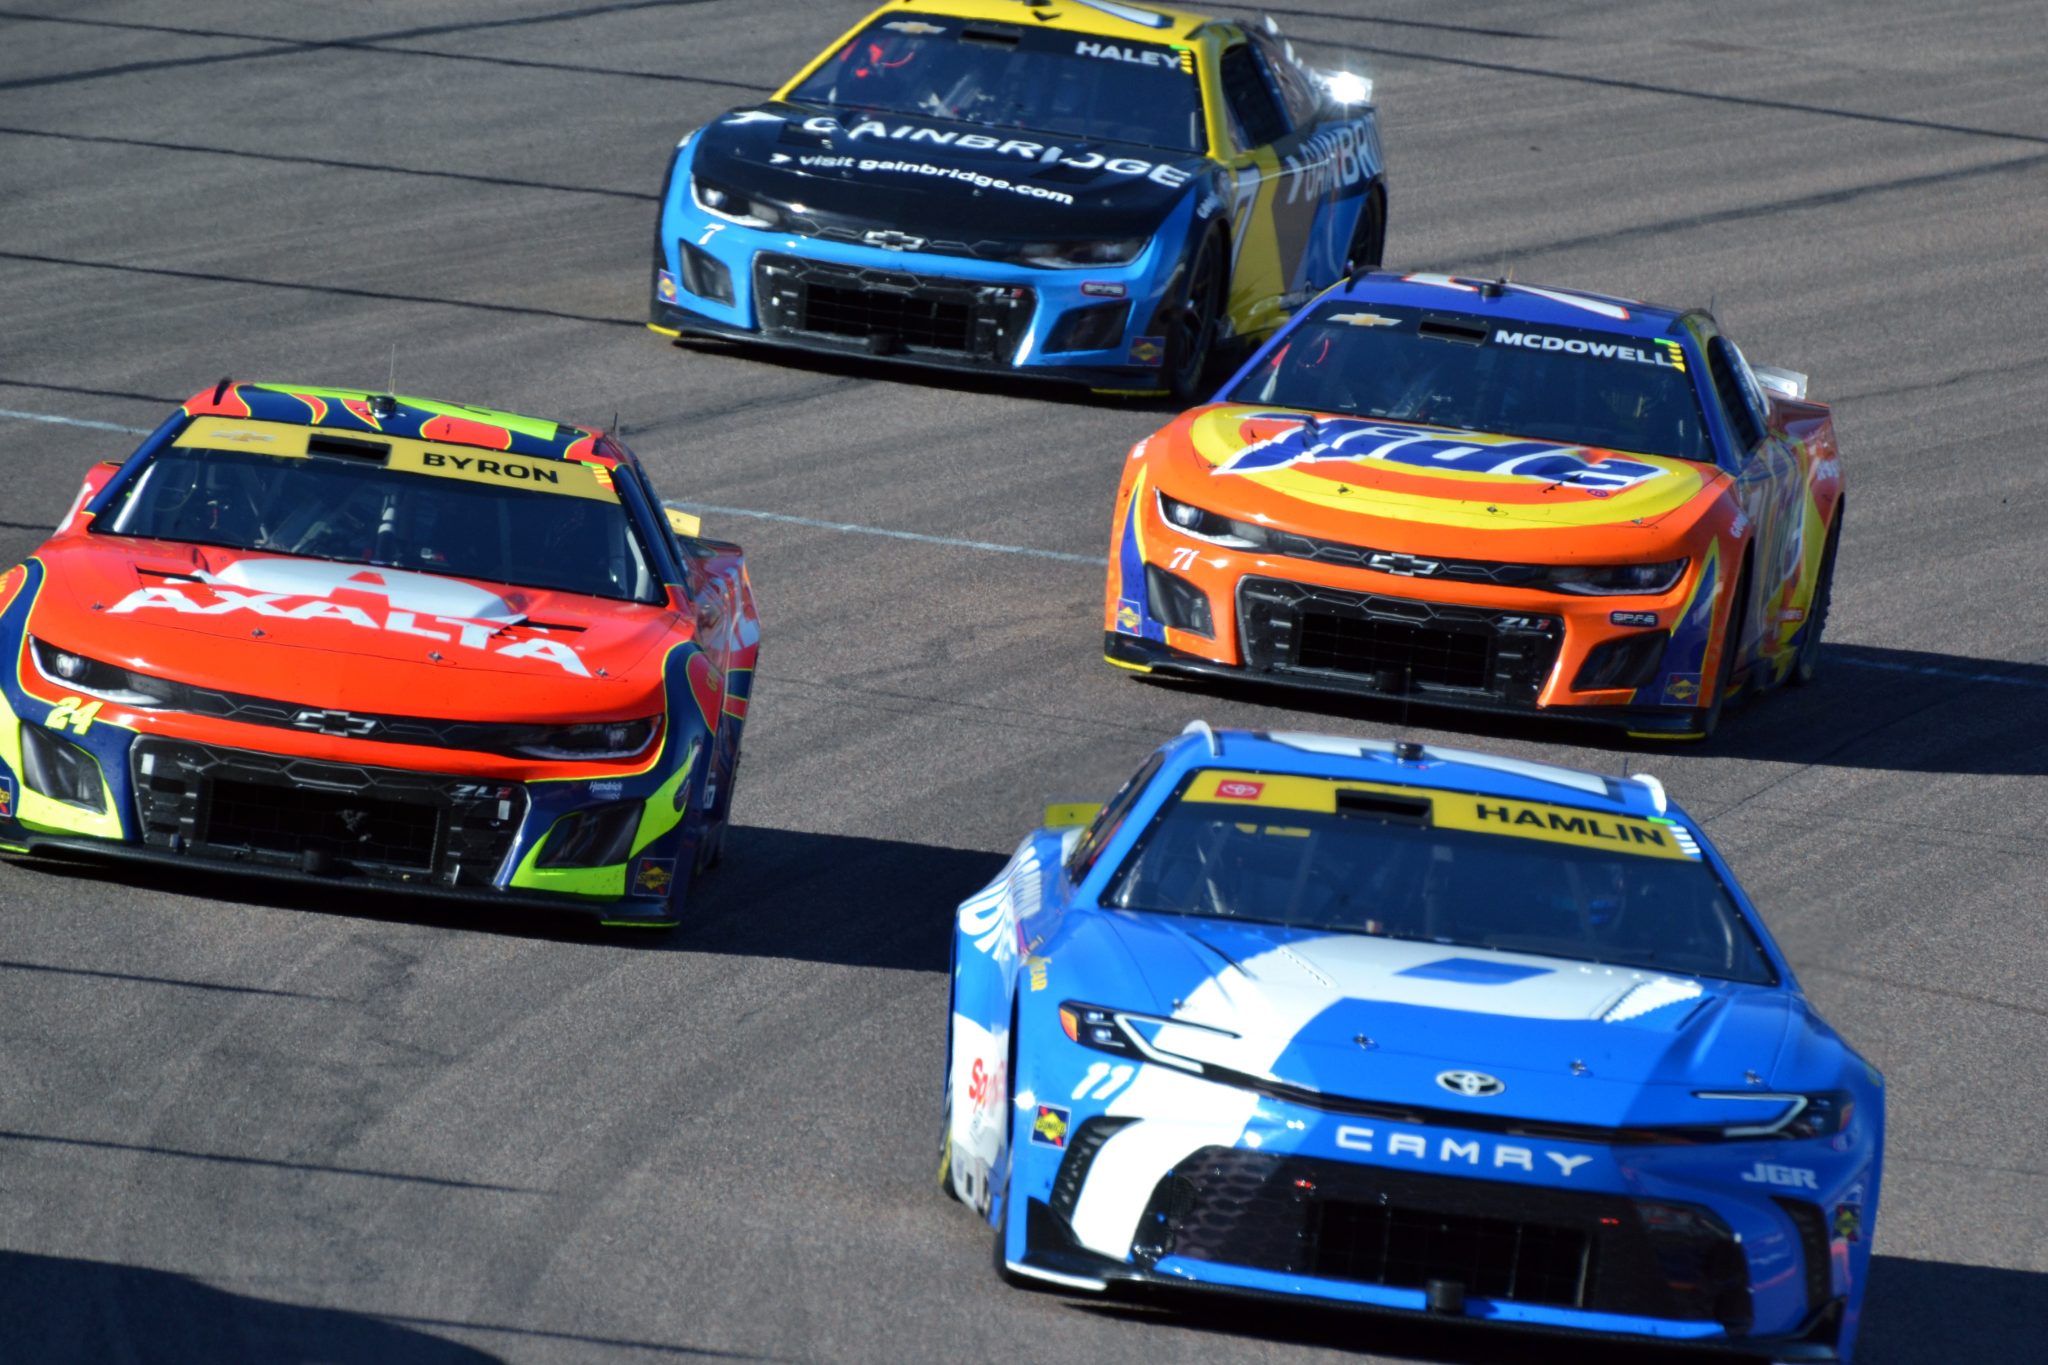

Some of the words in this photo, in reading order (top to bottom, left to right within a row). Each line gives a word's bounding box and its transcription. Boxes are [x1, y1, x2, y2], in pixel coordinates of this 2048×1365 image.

[1075, 41, 1181, 69] HALEY
[803, 116, 1193, 189] GAINBRIDGE
[799, 153, 855, 169] visit
[859, 158, 1074, 205] gainbridge.com
[698, 223, 727, 245] 7
[1495, 329, 1673, 367] MCDOWELL
[423, 452, 558, 484] BYRON
[1168, 547, 1200, 571] 71
[106, 587, 593, 678] AXALTA
[44, 696, 104, 736] 24
[1476, 803, 1666, 847] HAMLIN
[1071, 1062, 1135, 1100] 11
[1335, 1125, 1594, 1177] CAMRY
[1740, 1163, 1819, 1190] JGR
